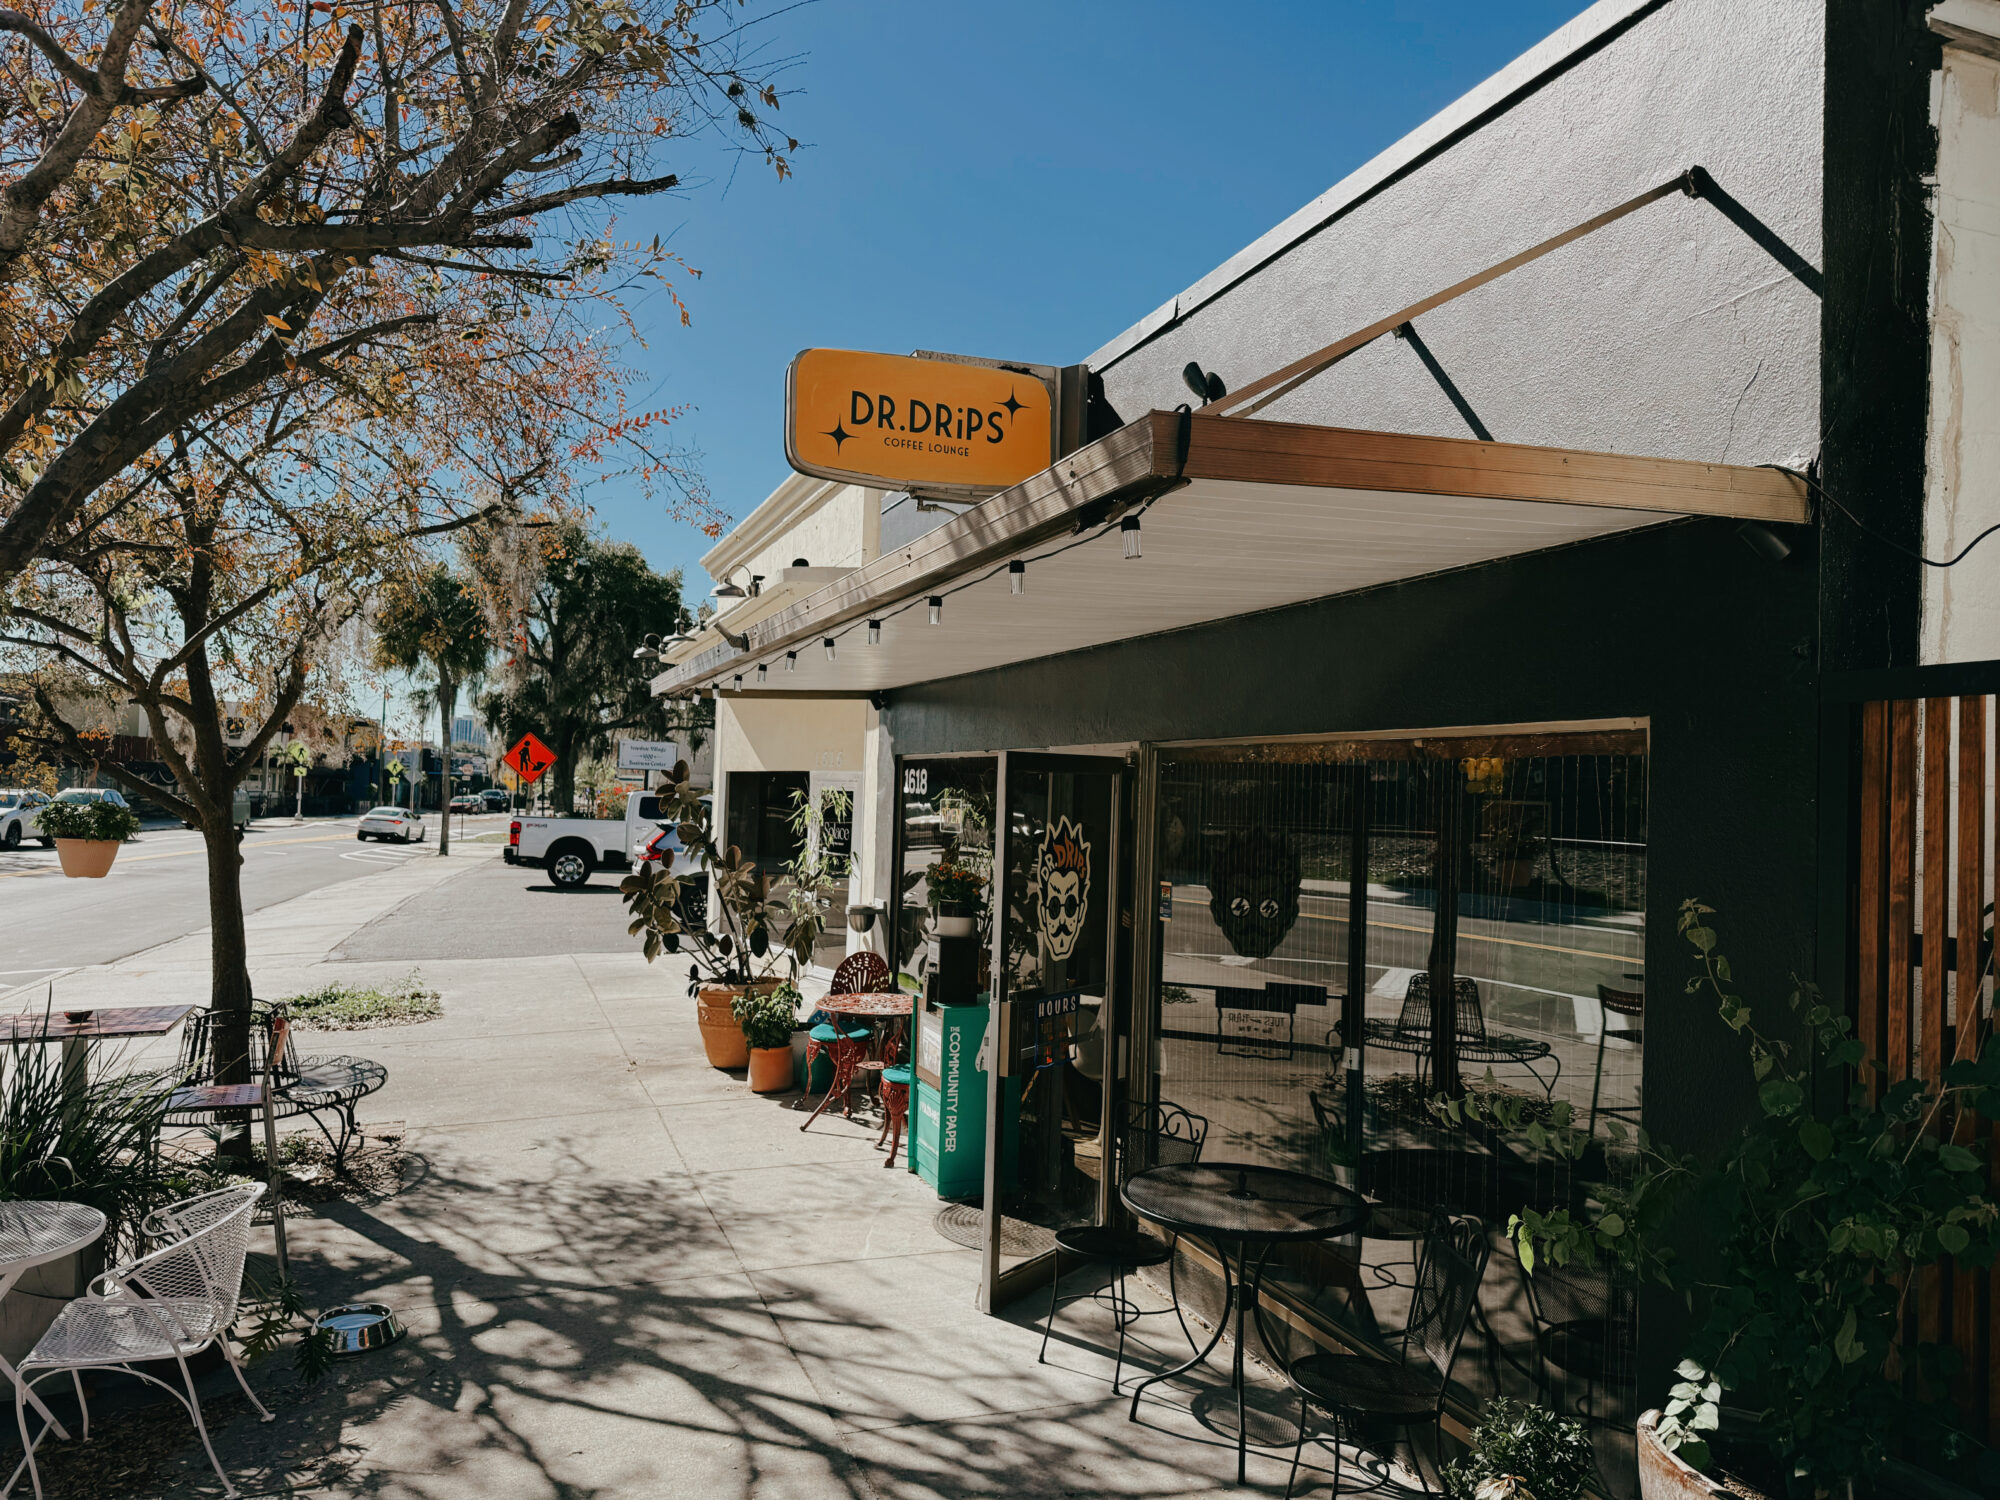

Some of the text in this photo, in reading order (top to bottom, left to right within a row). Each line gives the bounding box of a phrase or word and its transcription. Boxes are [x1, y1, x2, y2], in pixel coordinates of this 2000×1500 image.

[884, 437, 969, 457] COFFEE LOUNGE
[903, 768, 928, 795] 1618
[824, 822, 850, 842] Solace
[1038, 995, 1076, 1018] HOURS
[944, 1032, 961, 1153] COMMUNITY PAPER
